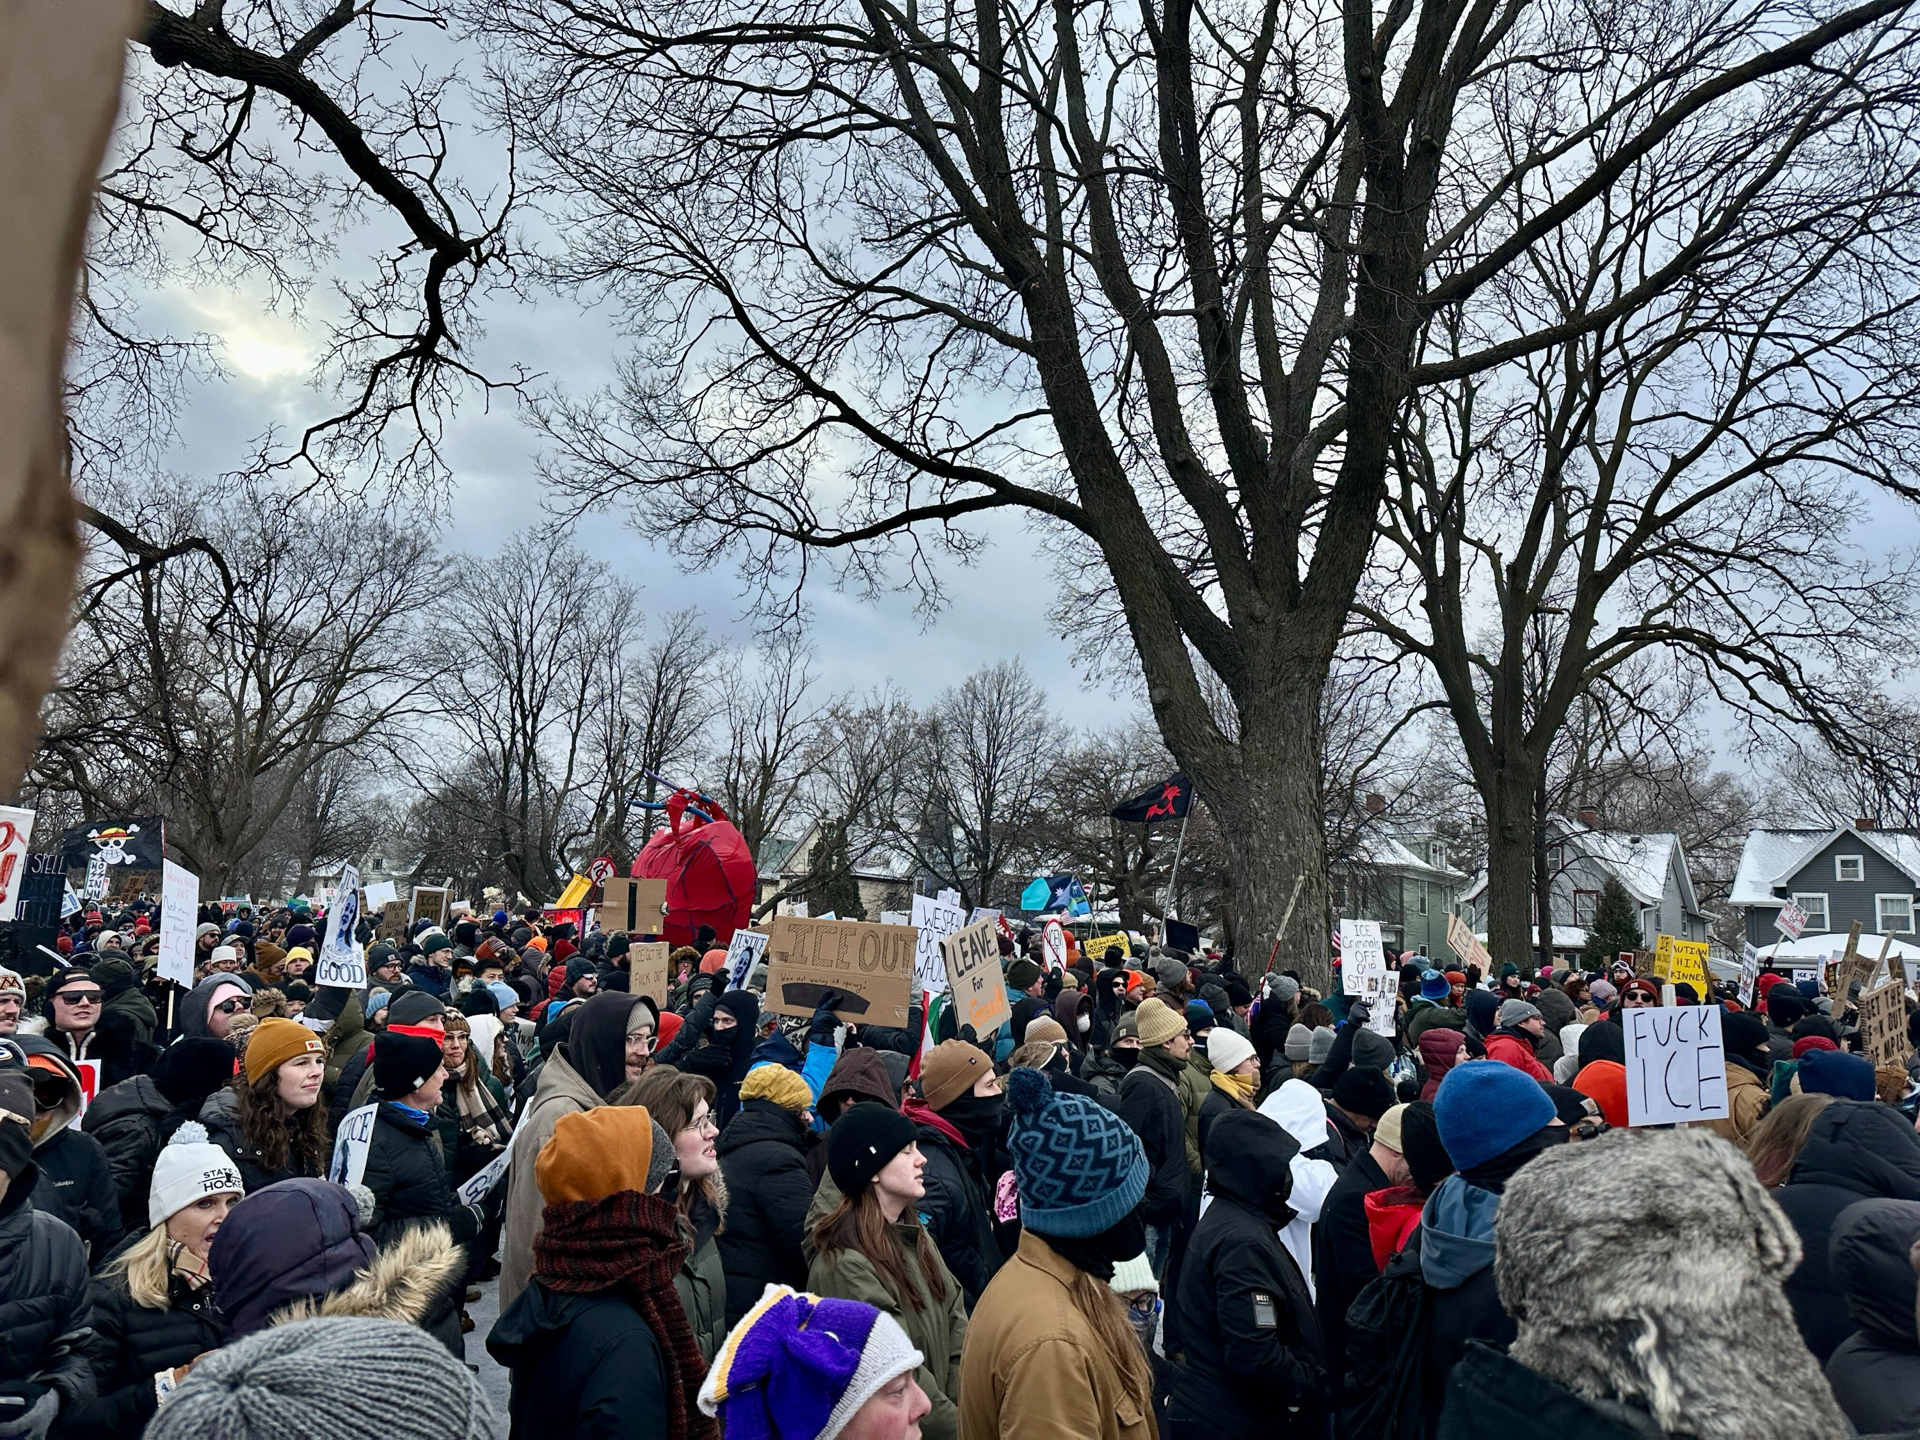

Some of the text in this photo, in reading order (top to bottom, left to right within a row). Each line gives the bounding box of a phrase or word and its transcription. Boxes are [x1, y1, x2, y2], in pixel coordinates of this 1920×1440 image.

[31, 853, 66, 875] SPELL
[88, 879, 102, 889] IN
[85, 889, 100, 900] MN
[420, 894, 440, 907] ICE
[923, 904, 942, 930] WE
[1783, 903, 1806, 926] NATION
[1353, 924, 1372, 937] ICE
[730, 933, 767, 955] JUSTICE
[917, 927, 933, 955] OR
[1342, 935, 1381, 950] Criminals
[1453, 924, 1472, 958] ICE
[729, 949, 739, 962] for
[787, 923, 857, 970] ICE
[858, 929, 920, 975] OUT
[1087, 945, 1107, 955] MISSIN
[1354, 950, 1378, 963] OFF
[1673, 944, 1708, 956] AUTION
[1675, 956, 1701, 969] HIN
[319, 959, 365, 983] GOOD
[1671, 970, 1706, 983] KINNED
[634, 972, 651, 986] FUCK
[1866, 985, 1902, 1020] GET THE
[1888, 1007, 1903, 1032] OUT
[1633, 1007, 1710, 1058] FUCK
[1884, 1031, 1905, 1060] MPLS
[1642, 1045, 1722, 1115] ICE
[203, 1167, 232, 1179] STATE
[203, 1179, 243, 1193] HOCKE
